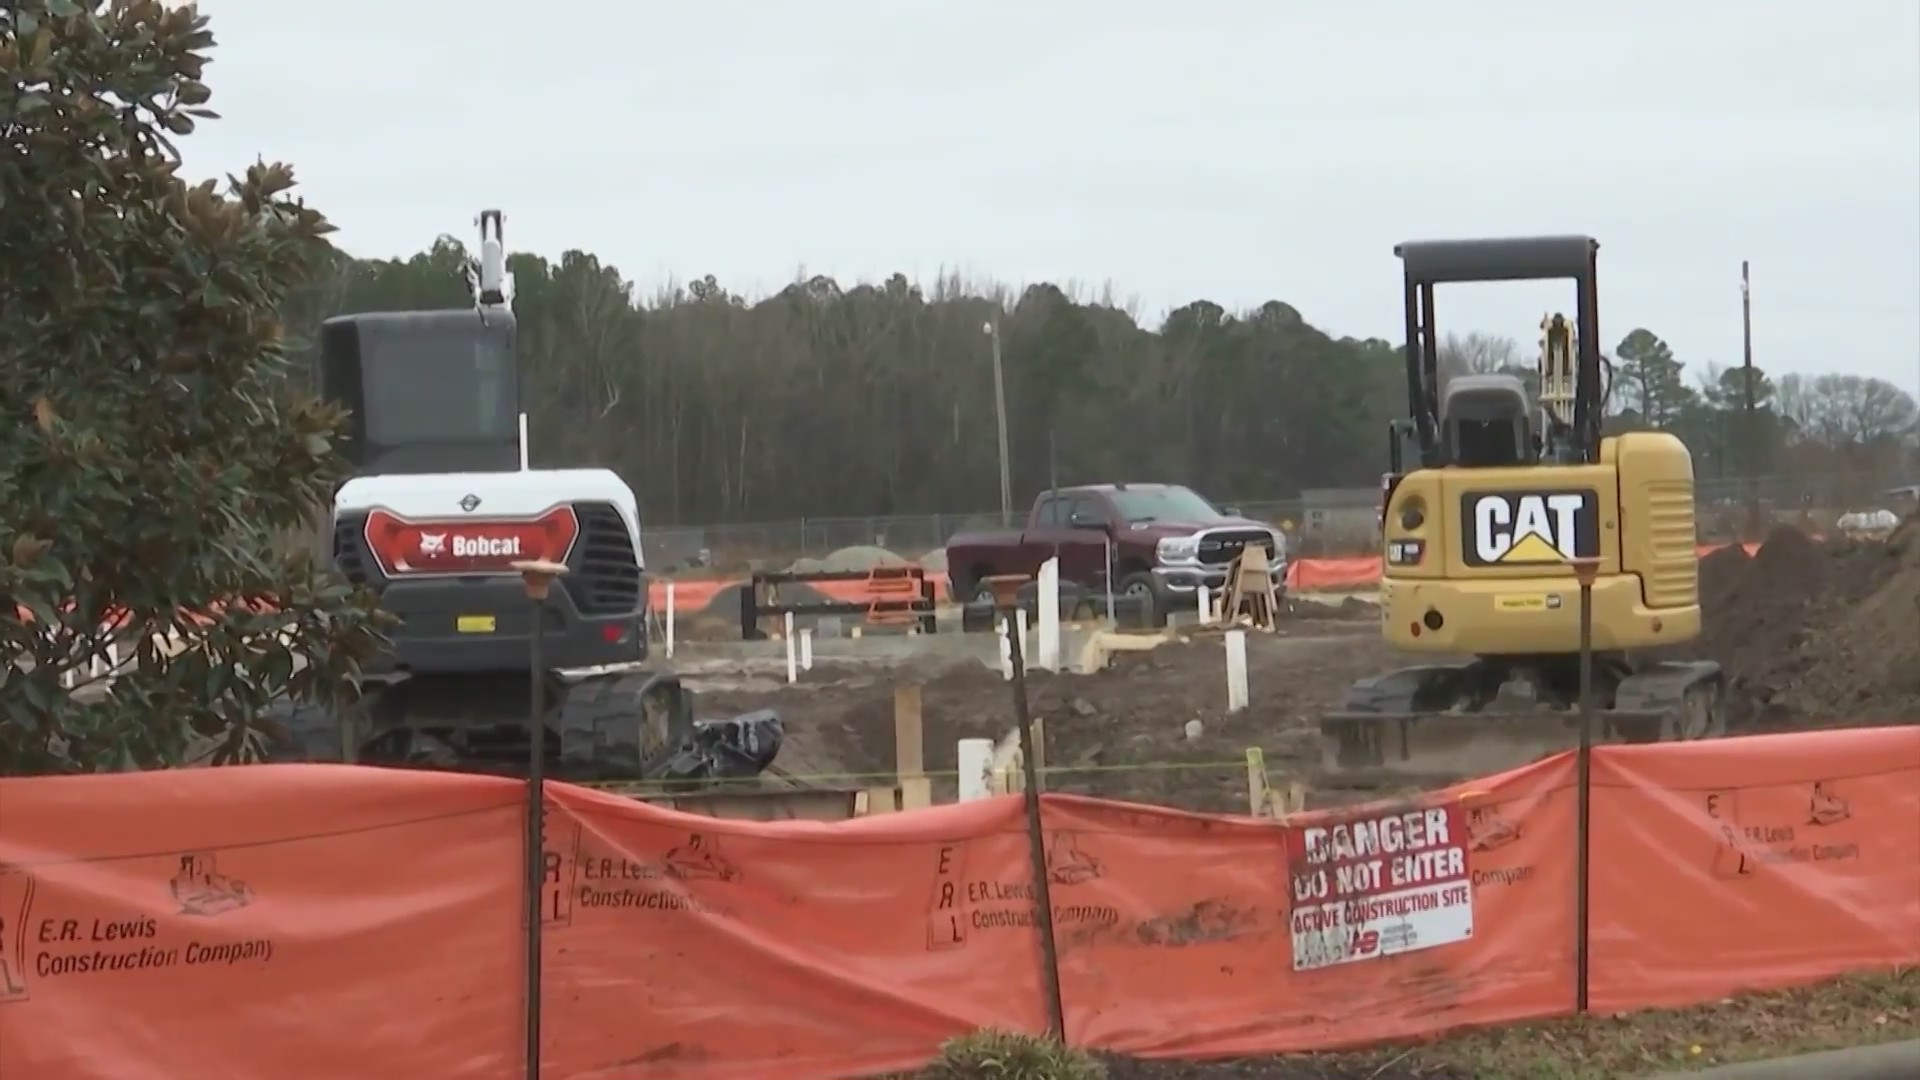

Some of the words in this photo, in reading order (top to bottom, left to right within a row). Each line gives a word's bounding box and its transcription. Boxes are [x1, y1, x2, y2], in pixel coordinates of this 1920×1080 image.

[452, 535, 520, 556] Bobcat
[1475, 495, 1583, 562] CAT
[1304, 808, 1449, 864] DANGER
[1293, 869, 1329, 901] DO
[1336, 860, 1384, 894] NOT
[1391, 847, 1465, 886] ENTER
[581, 886, 693, 911] Construction
[1294, 907, 1340, 935] ACTIVE
[1344, 891, 1439, 925] CONSTRUCTION
[1442, 885, 1468, 909] SITE
[38, 917, 83, 943] E.R.
[91, 913, 157, 942] Lewis
[36, 945, 179, 978] Construction
[185, 939, 273, 966] Company
